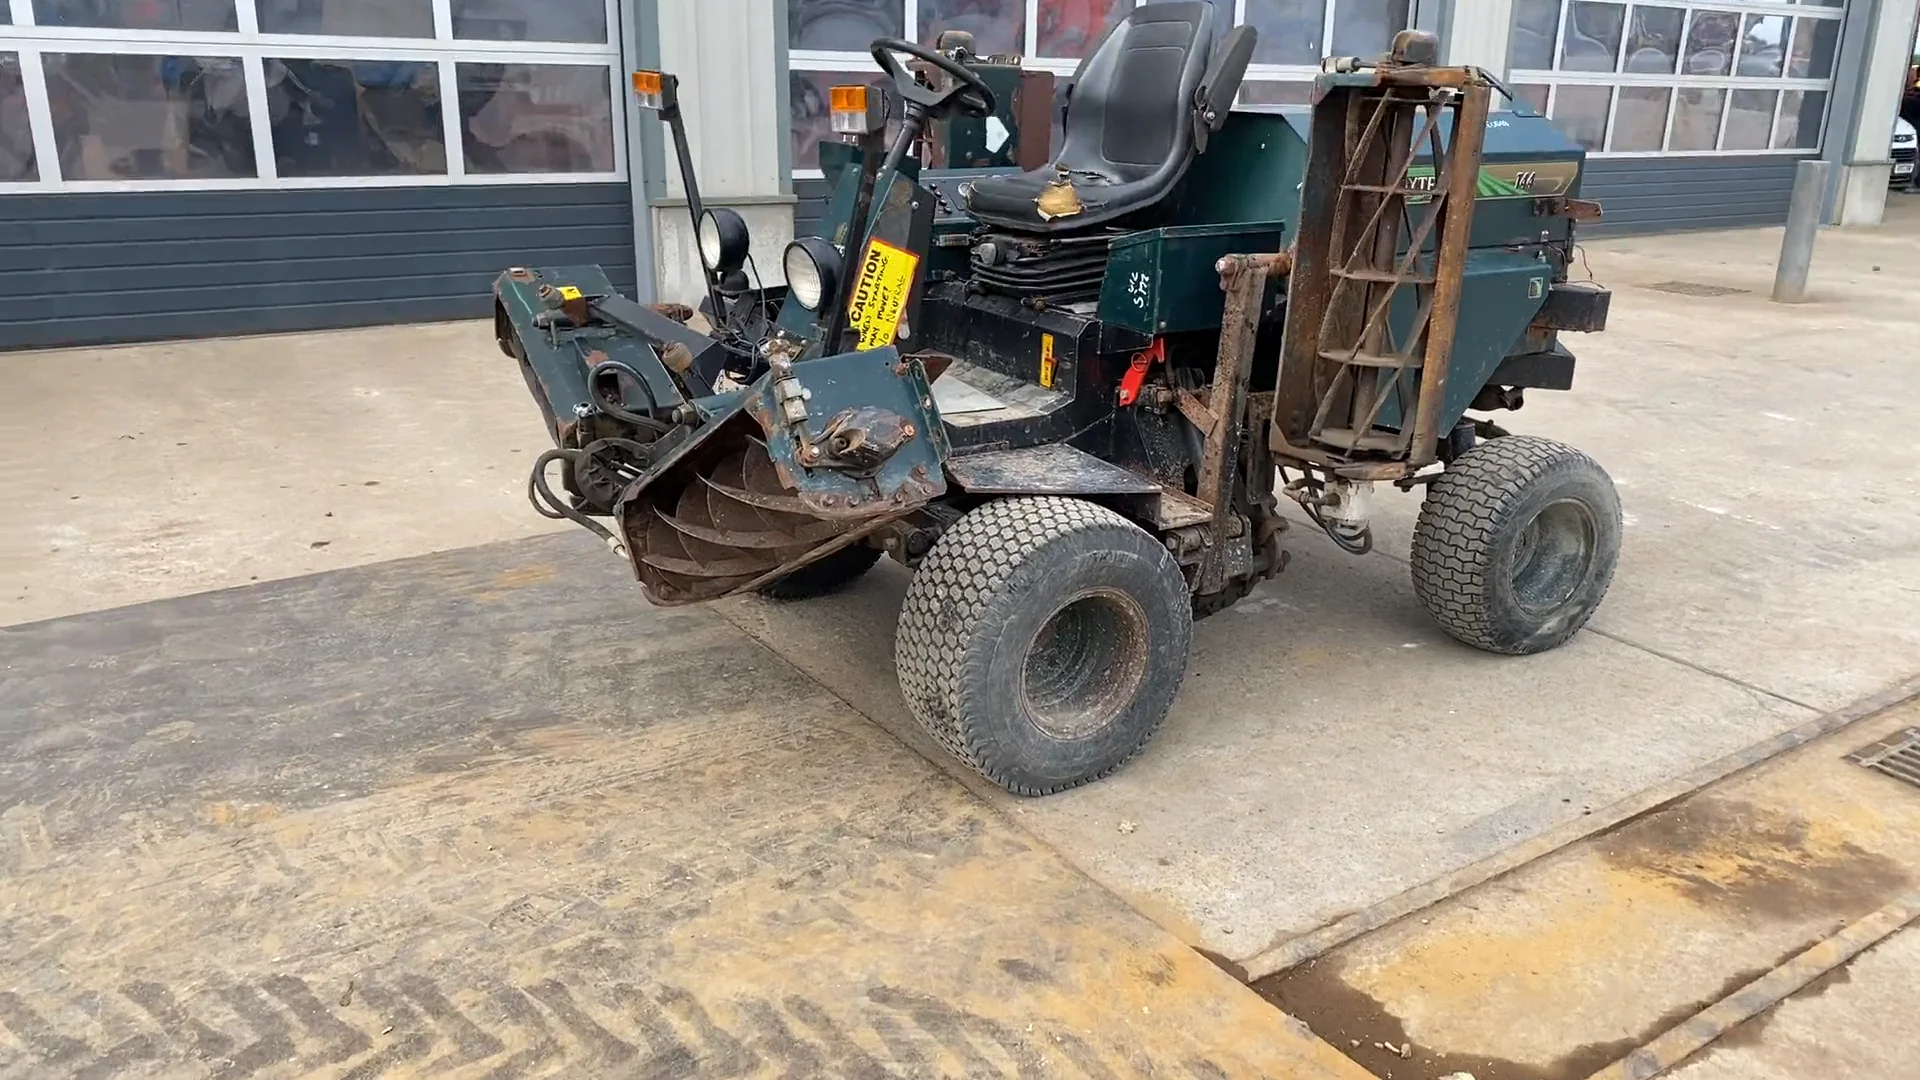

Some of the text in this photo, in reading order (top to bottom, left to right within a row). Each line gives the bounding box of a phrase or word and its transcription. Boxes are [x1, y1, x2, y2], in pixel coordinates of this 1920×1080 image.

[850, 249, 881, 323] CAUTION
[860, 315, 872, 343] WHEN
[869, 326, 881, 347] MAY
